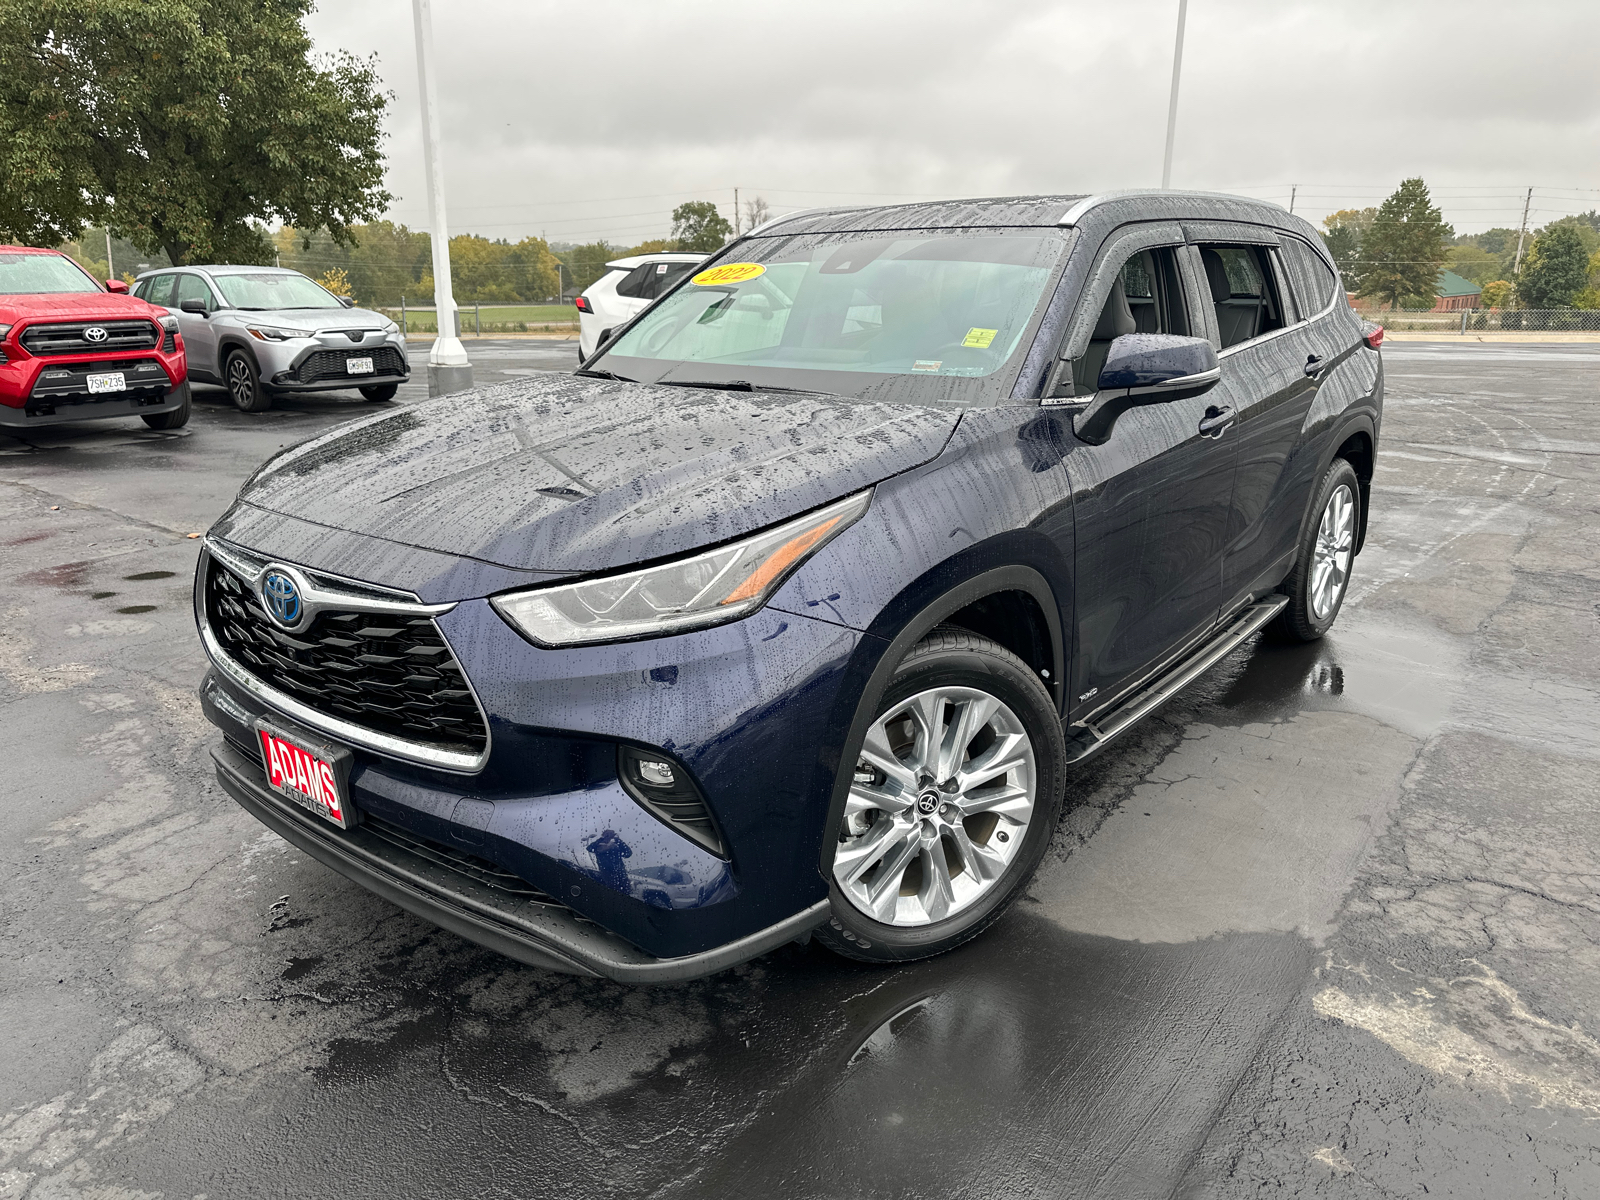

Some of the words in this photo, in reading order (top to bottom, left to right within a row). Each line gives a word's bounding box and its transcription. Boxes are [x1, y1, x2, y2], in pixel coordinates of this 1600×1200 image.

[698, 267, 757, 282] 2022
[89, 378, 105, 389] 7SH
[108, 376, 124, 388] Z35
[268, 735, 339, 811] ADAMS
